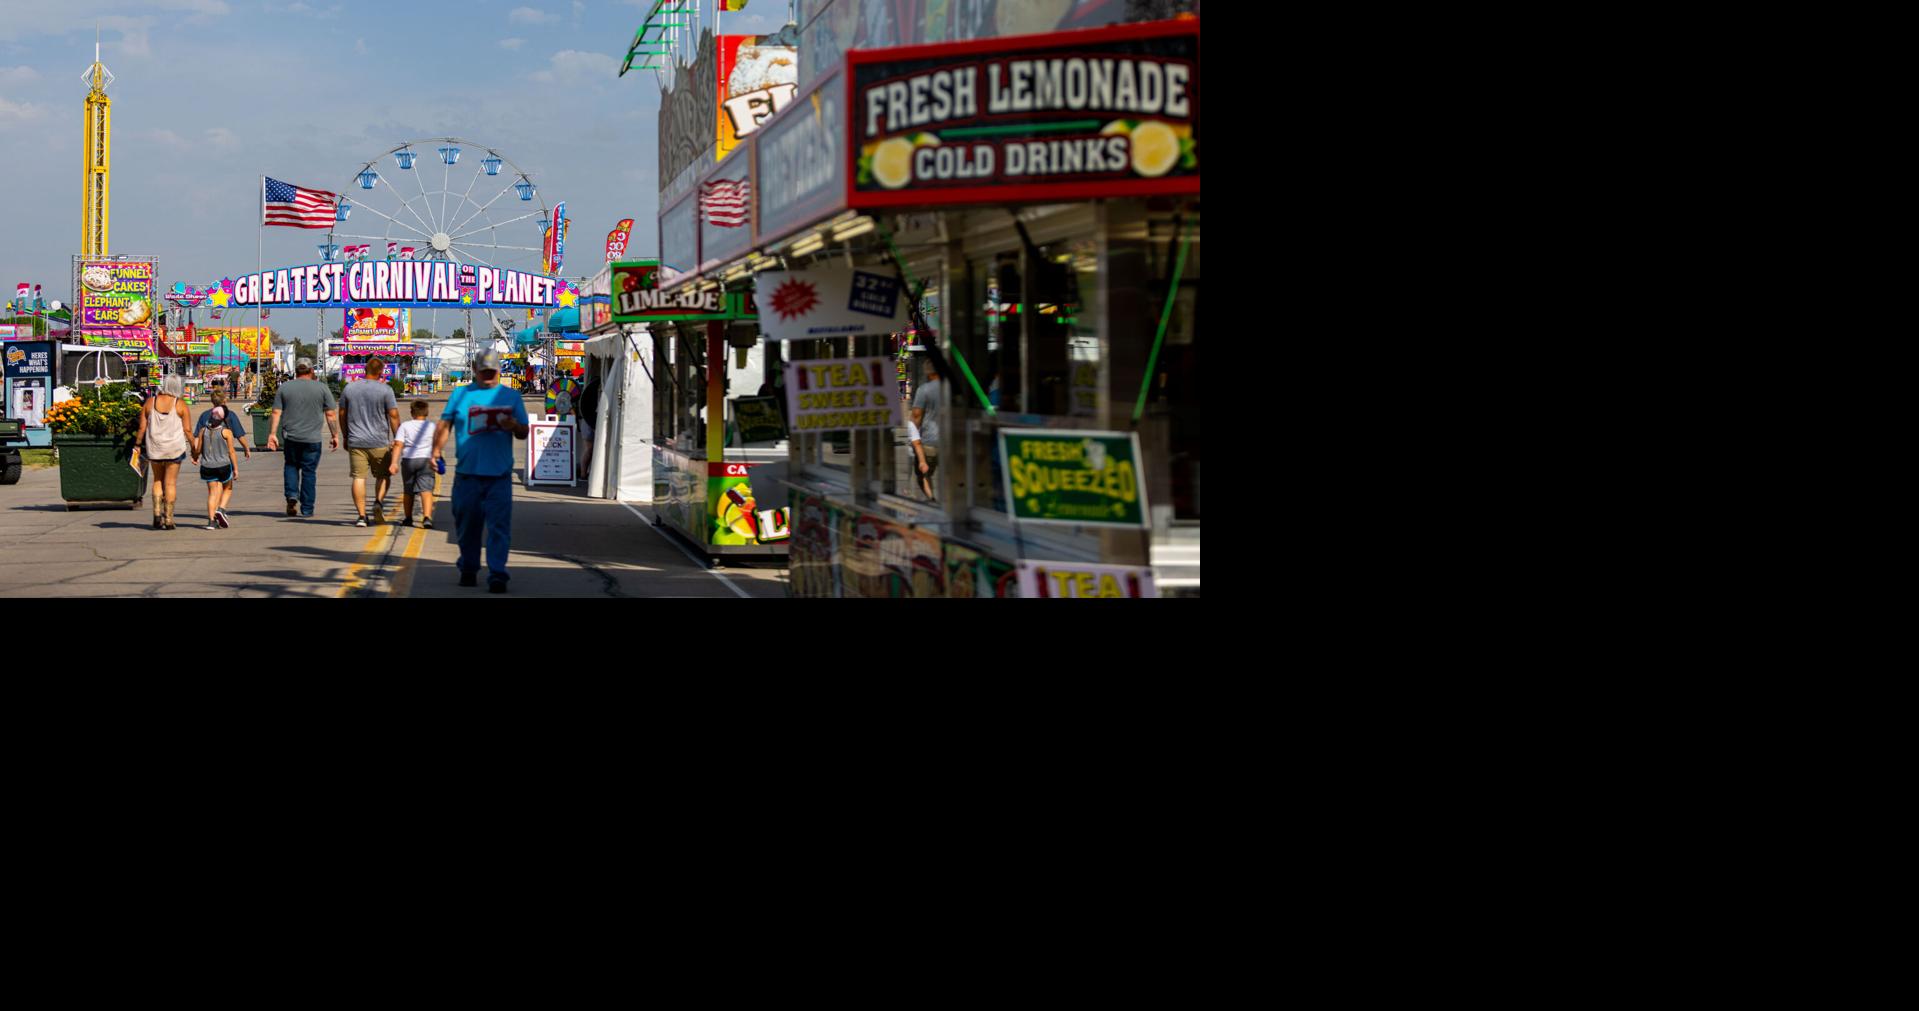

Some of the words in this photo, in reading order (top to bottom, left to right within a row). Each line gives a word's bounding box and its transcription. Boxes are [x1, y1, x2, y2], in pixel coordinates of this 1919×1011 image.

[866, 67, 977, 136] FRESH
[988, 58, 1190, 117] LEMONADE
[915, 143, 995, 180] COLD
[1004, 138, 1129, 176] DRINKS
[110, 268, 149, 279] FUNNEL
[460, 274, 476, 285] THE
[462, 265, 474, 274] ON
[113, 281, 146, 292] CAKES
[234, 263, 344, 304] GREATEST
[349, 261, 460, 301] CARNIVAL
[478, 265, 556, 305] PLANET
[84, 297, 130, 307] ELEPHANT
[620, 290, 719, 314] LIMEADE
[95, 310, 119, 320] EARS
[811, 362, 869, 388] TEA
[798, 389, 868, 410] SWEET
[796, 409, 892, 429] UNSWEET
[1020, 440, 1083, 461] FRESH
[1009, 454, 1137, 503] SQUEEZED
[1050, 571, 1122, 598] TEA
